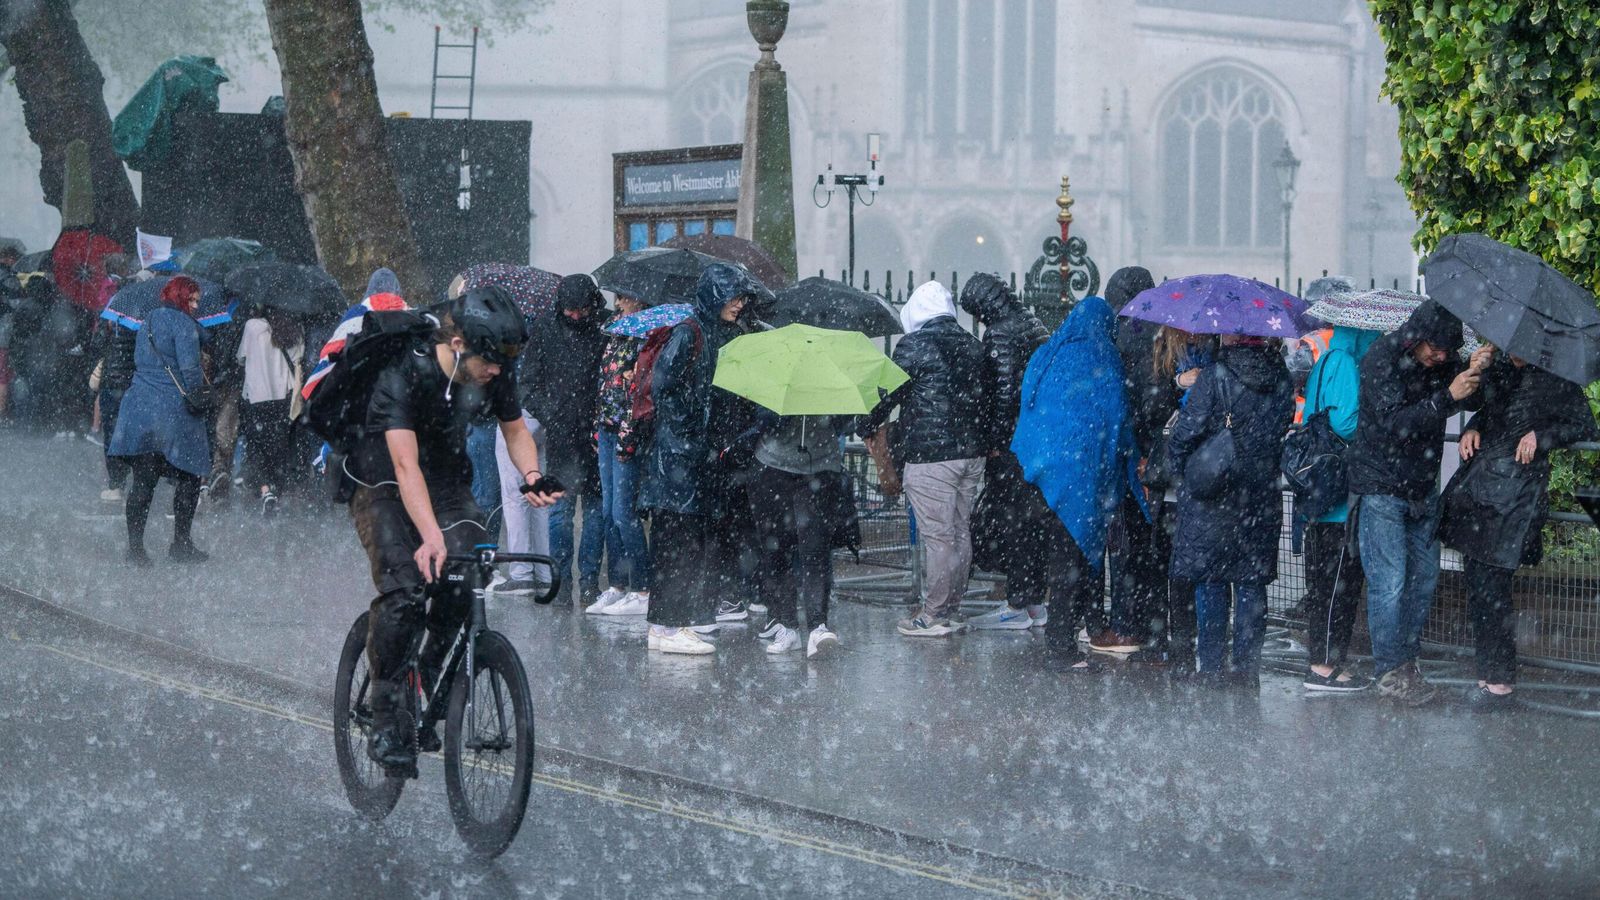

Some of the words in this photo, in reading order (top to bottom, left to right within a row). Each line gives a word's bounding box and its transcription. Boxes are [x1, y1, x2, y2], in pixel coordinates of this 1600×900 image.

[627, 177, 662, 195] Welcome
[663, 178, 672, 193] to
[673, 174, 724, 192] Westminster
